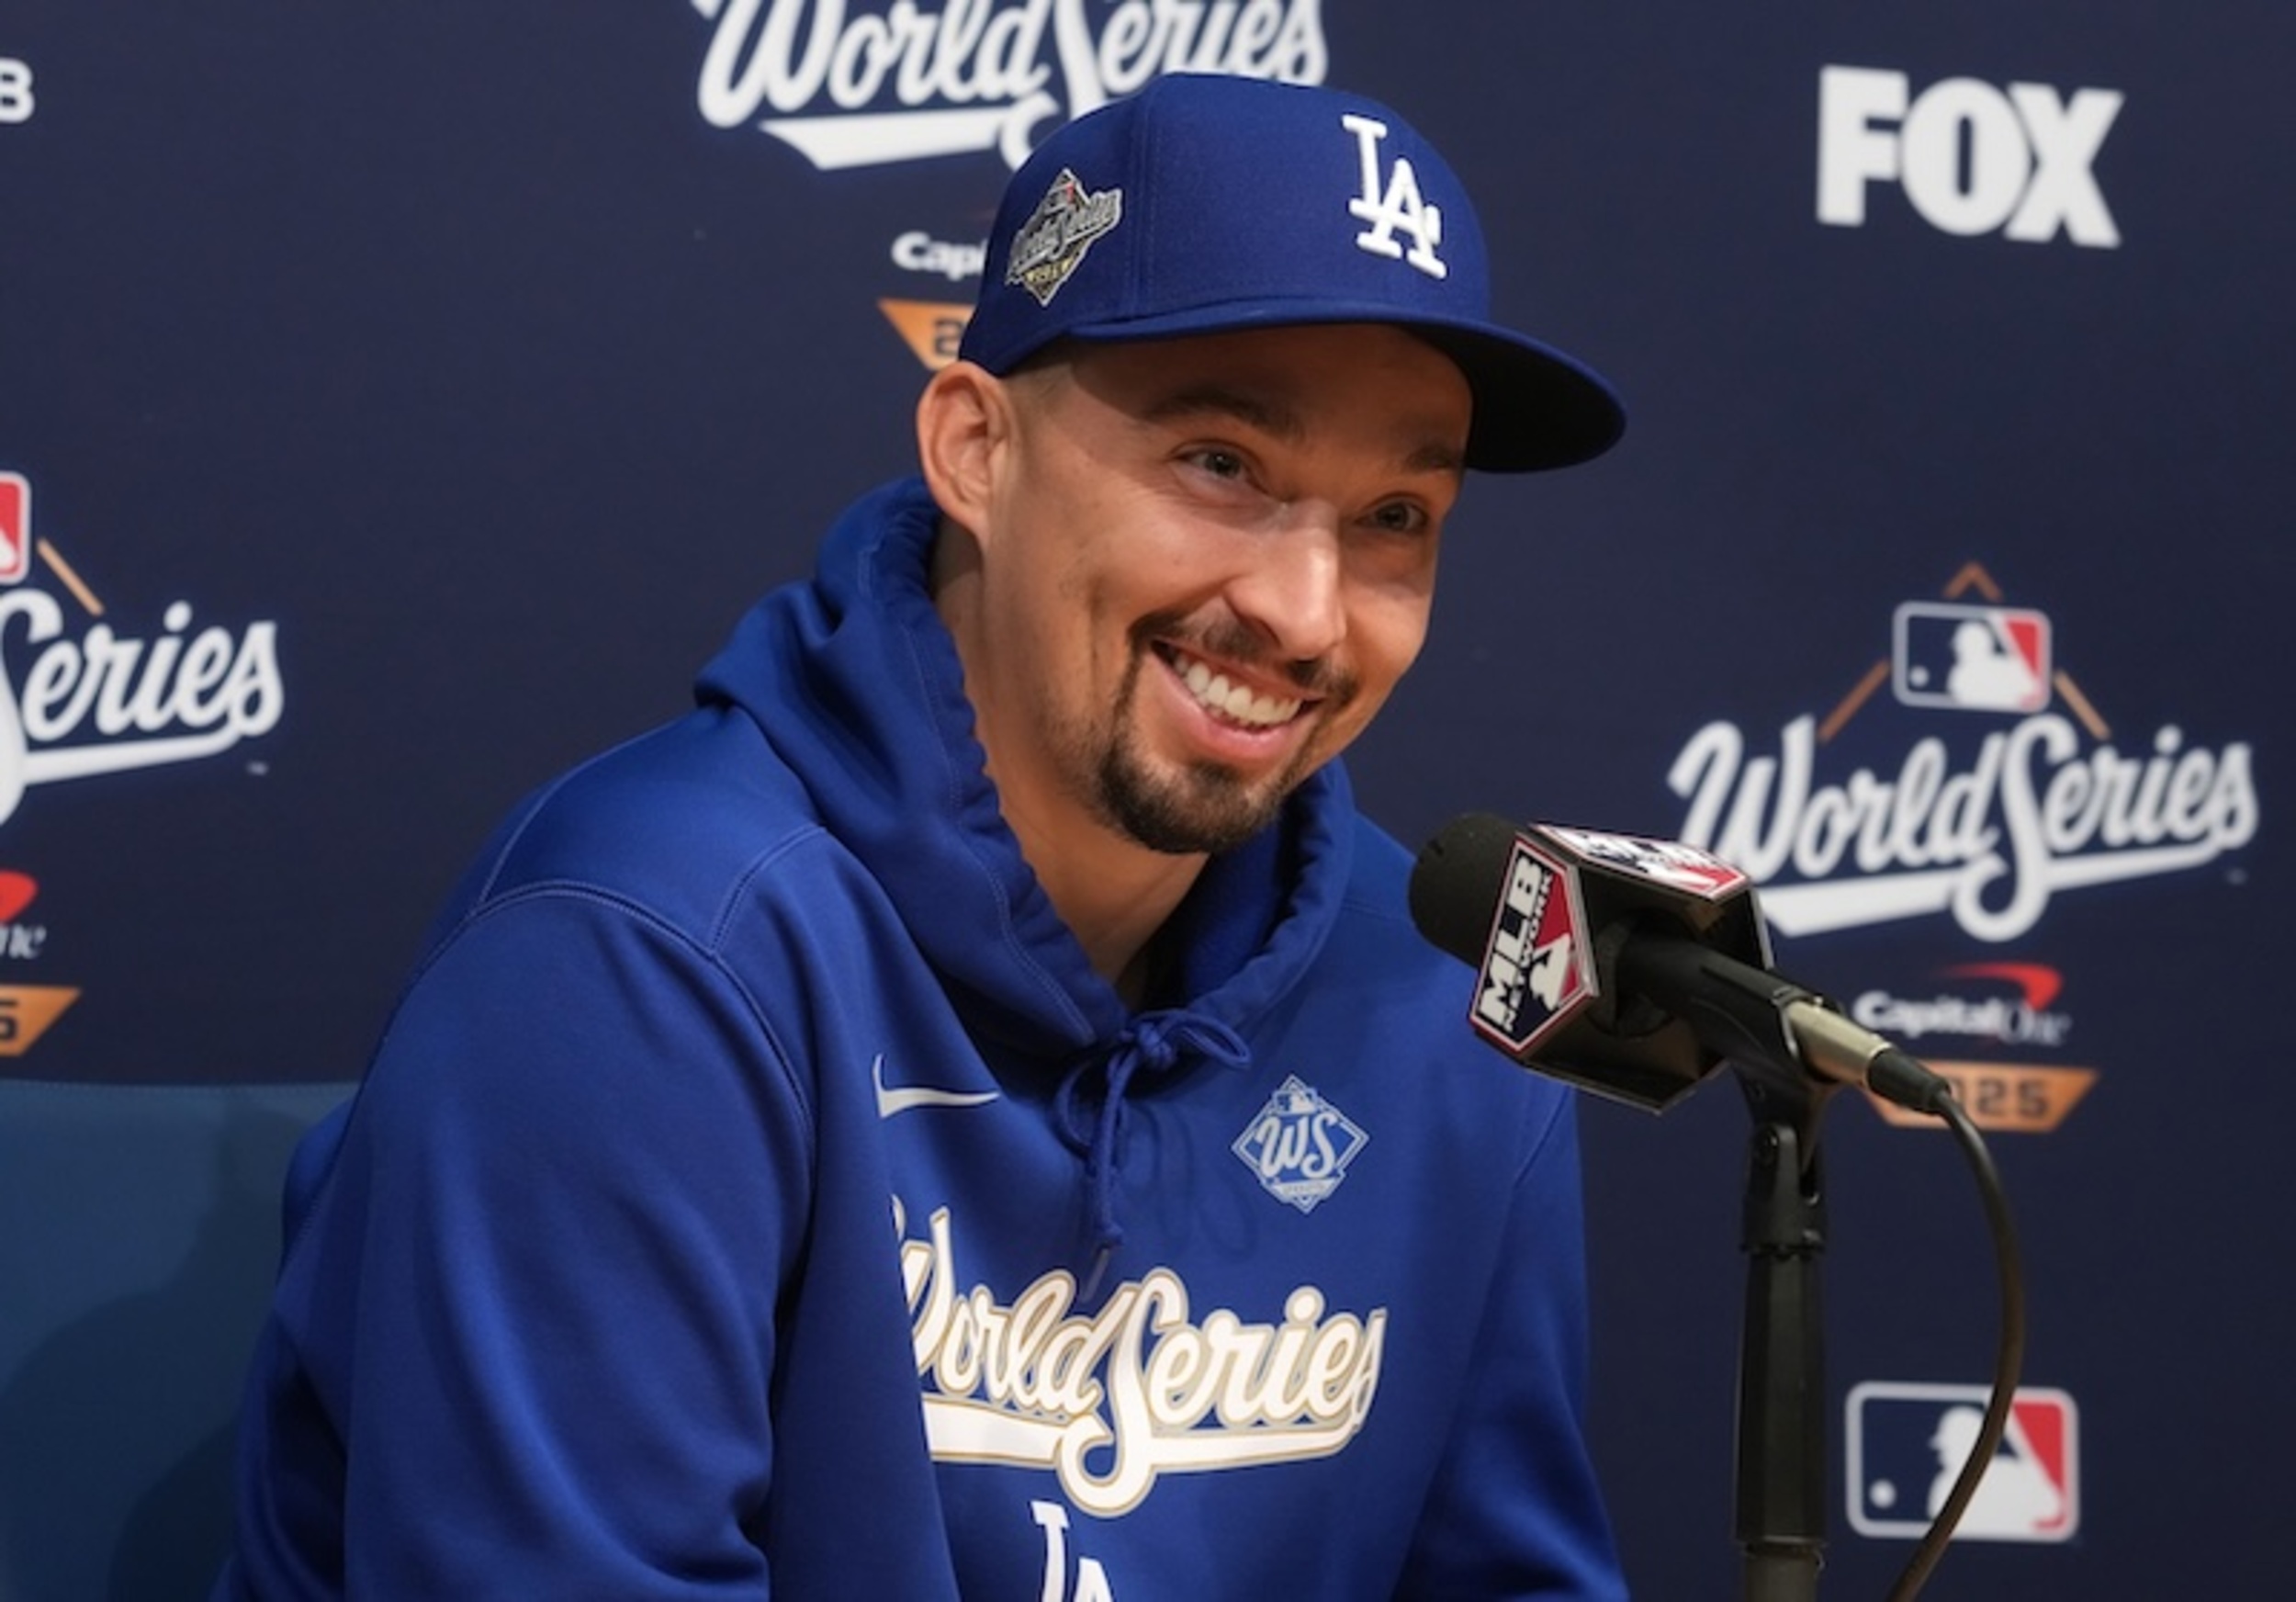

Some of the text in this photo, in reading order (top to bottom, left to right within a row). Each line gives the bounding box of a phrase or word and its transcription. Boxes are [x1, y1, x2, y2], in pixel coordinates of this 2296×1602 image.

[695, 0, 1052, 128] World
[1341, 114, 1447, 279] LA
[1816, 64, 2126, 249] FOX
[1667, 713, 2258, 942] World Series
[1479, 856, 1543, 1026] MLB
[1254, 1112, 1338, 1179] WS
[1056, 1267, 1387, 1517] Series
